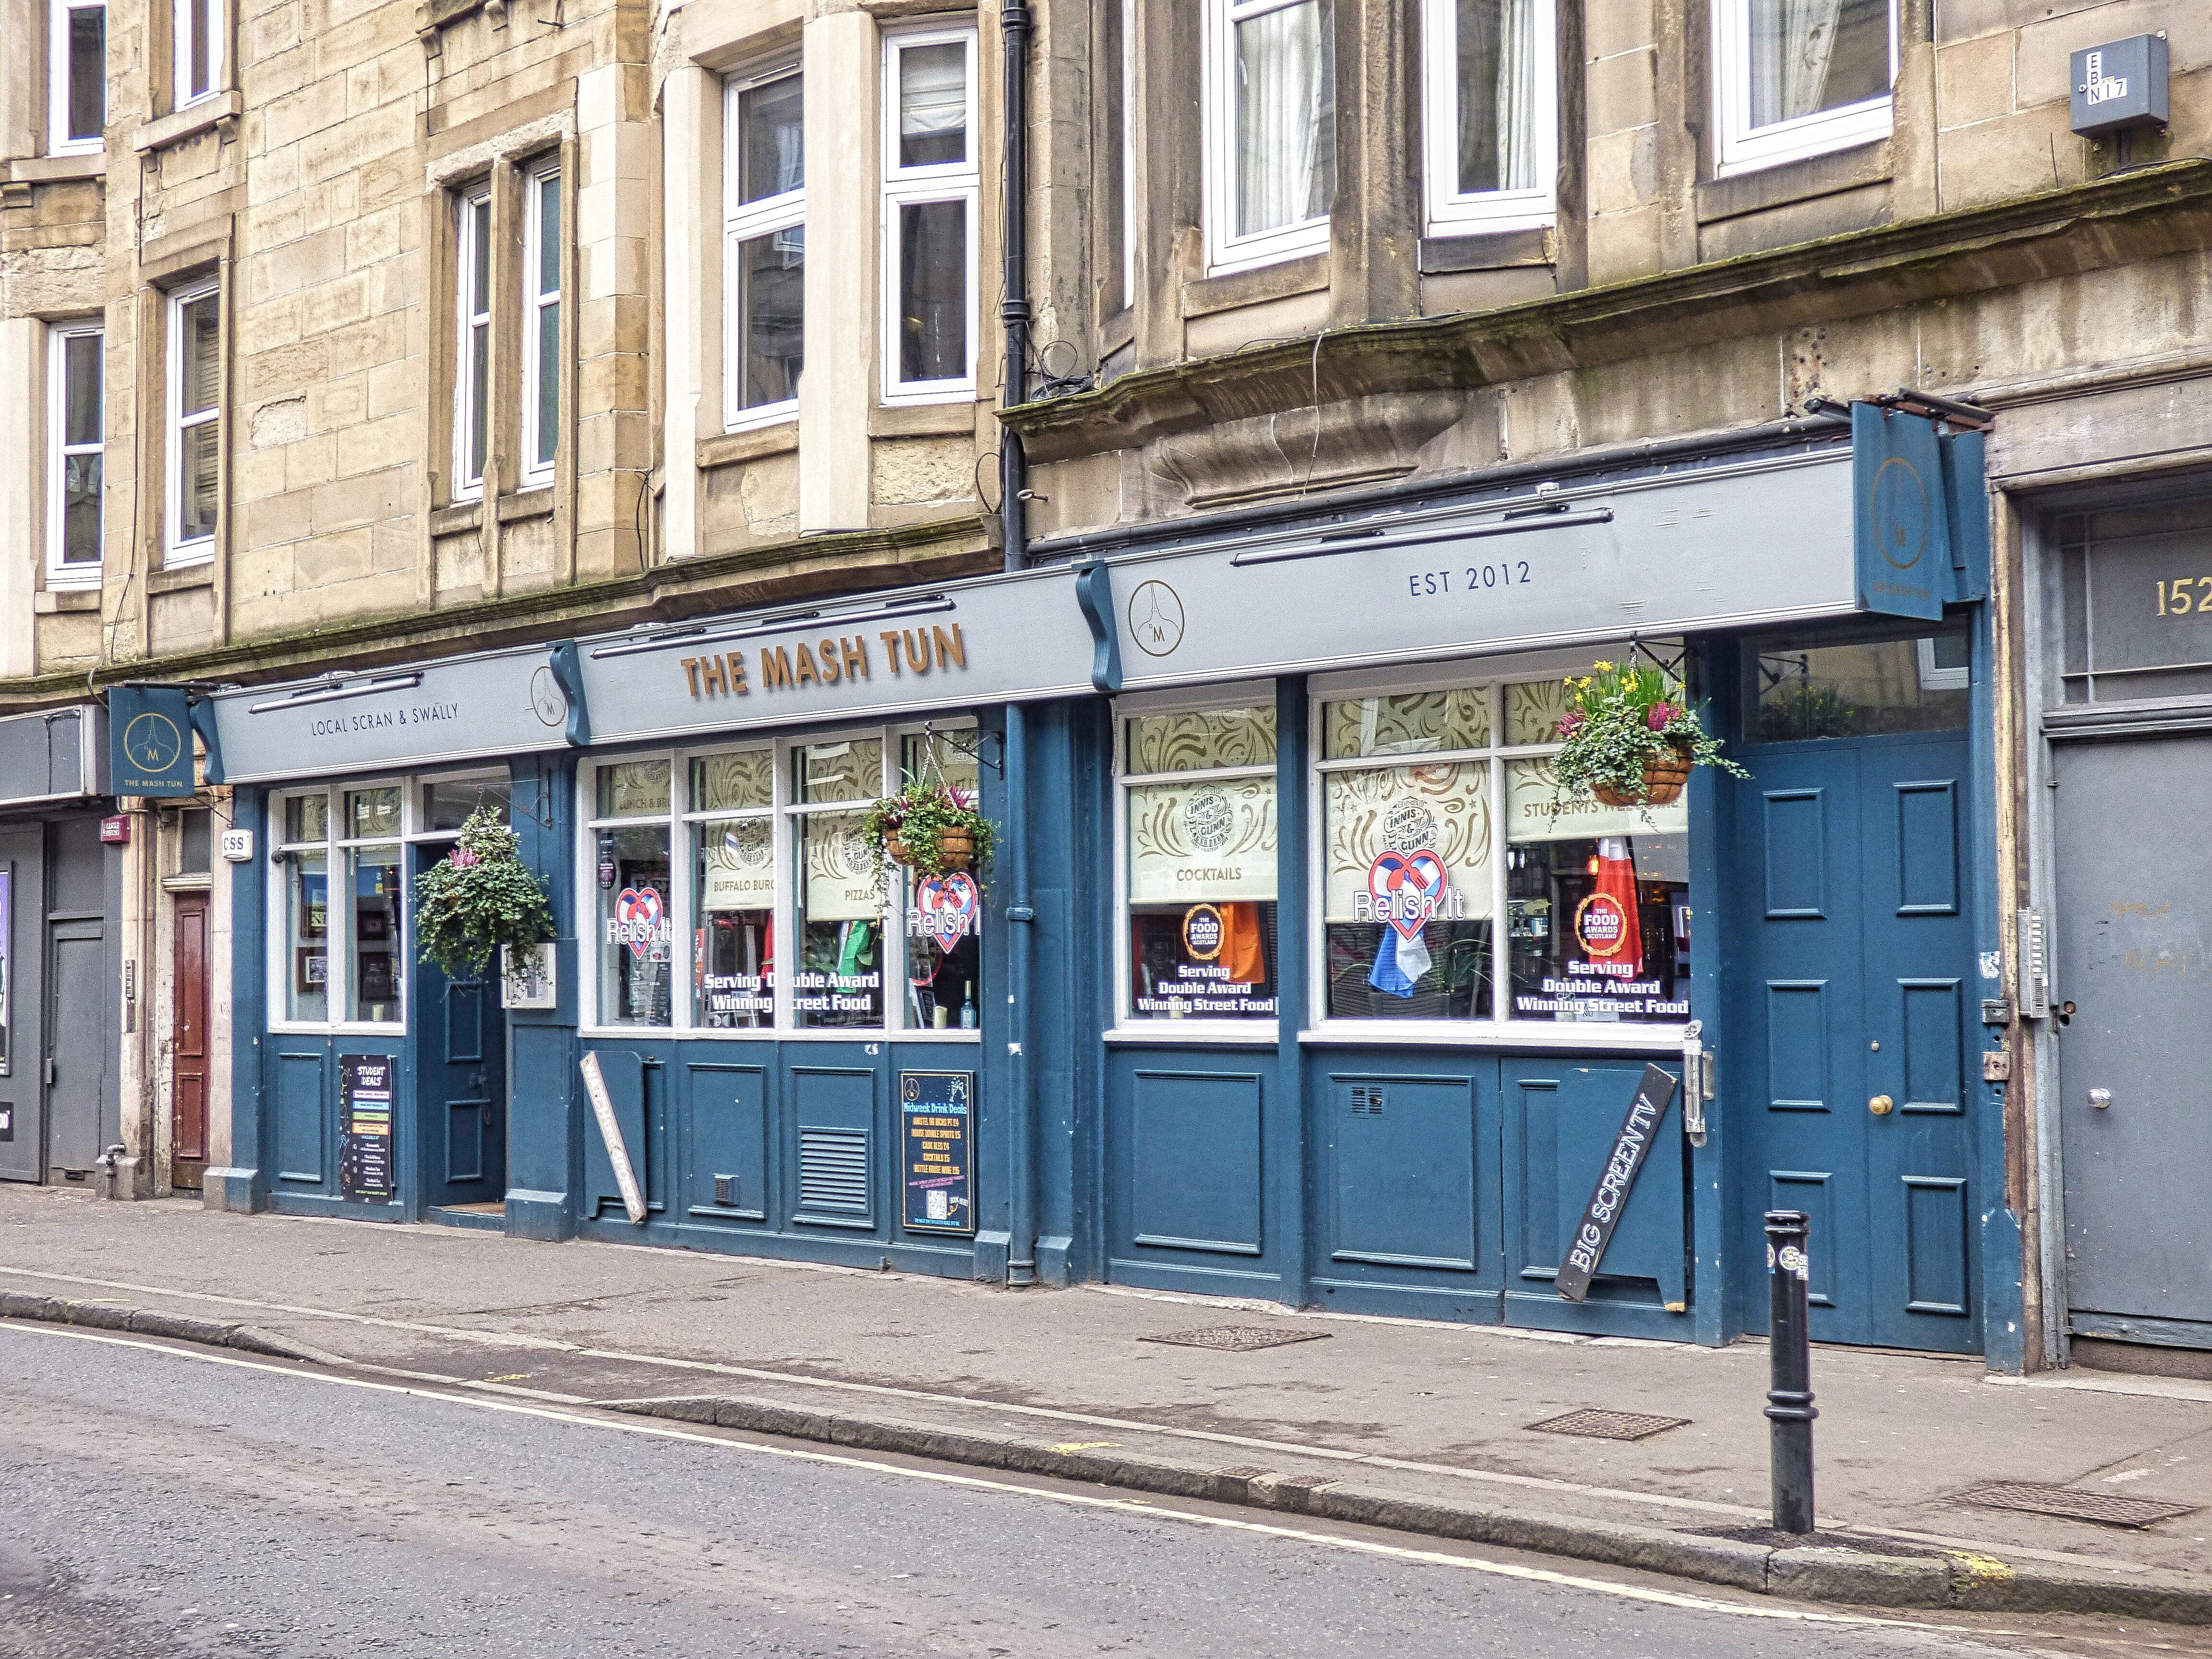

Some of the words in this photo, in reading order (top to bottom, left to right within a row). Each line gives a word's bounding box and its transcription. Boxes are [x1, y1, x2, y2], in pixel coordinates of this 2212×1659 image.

[1409, 571, 1450, 596] EST
[1466, 561, 1531, 590] 2012
[680, 651, 747, 697] THE
[761, 635, 868, 688] MASH
[880, 623, 965, 673] TUN
[312, 718, 349, 736] LOCAL
[353, 711, 393, 731] SCRAN
[399, 709, 407, 724] &
[412, 703, 458, 724] SWALLY
[1190, 796, 1214, 815] INNIS
[1205, 810, 1213, 819] &
[1390, 809, 1416, 828] INNIS
[1200, 817, 1226, 836] GUNN
[1407, 823, 1415, 834] &
[1401, 830, 1429, 851] GUNN
[1177, 867, 1242, 881] COCKTAILS
[714, 879, 751, 892] BUFFALO
[845, 889, 875, 901] PIZZAS
[1354, 888, 1437, 922] Relish
[1446, 886, 1465, 920] It
[907, 907, 969, 937] Relish
[1190, 923, 1218, 933] FOOD
[1584, 914, 1619, 926] FOOD
[607, 917, 656, 944] Relish
[661, 916, 671, 943] It
[1178, 965, 1230, 980] Serving
[1568, 961, 1634, 978] Serving
[704, 973, 761, 992] Serving
[766, 972, 825, 988] Duble
[828, 972, 880, 988] Award
[1158, 982, 1205, 994] Double
[1206, 982, 1252, 994] Award
[1542, 979, 1602, 994] Double
[1603, 980, 1661, 994] Award
[711, 994, 773, 1013] Winning
[792, 995, 830, 1010] treet
[832, 994, 872, 1010] Food
[1137, 998, 1192, 1013] Winning
[1193, 998, 1238, 1011] Street
[1239, 998, 1274, 1011] Food
[1516, 996, 1585, 1015] Winning
[1588, 998, 1644, 1013] Street
[1645, 999, 1689, 1014] Food
[357, 1066, 386, 1076] STUDENT
[361, 1076, 383, 1086] DEALS
[903, 1102, 931, 1113] Midweek
[931, 1103, 948, 1113] Drink
[949, 1103, 968, 1114] Deals
[1570, 1223, 1601, 1273] BIG
[1591, 1125, 1645, 1223] SCREEN
[1629, 1093, 1657, 1130] TV
